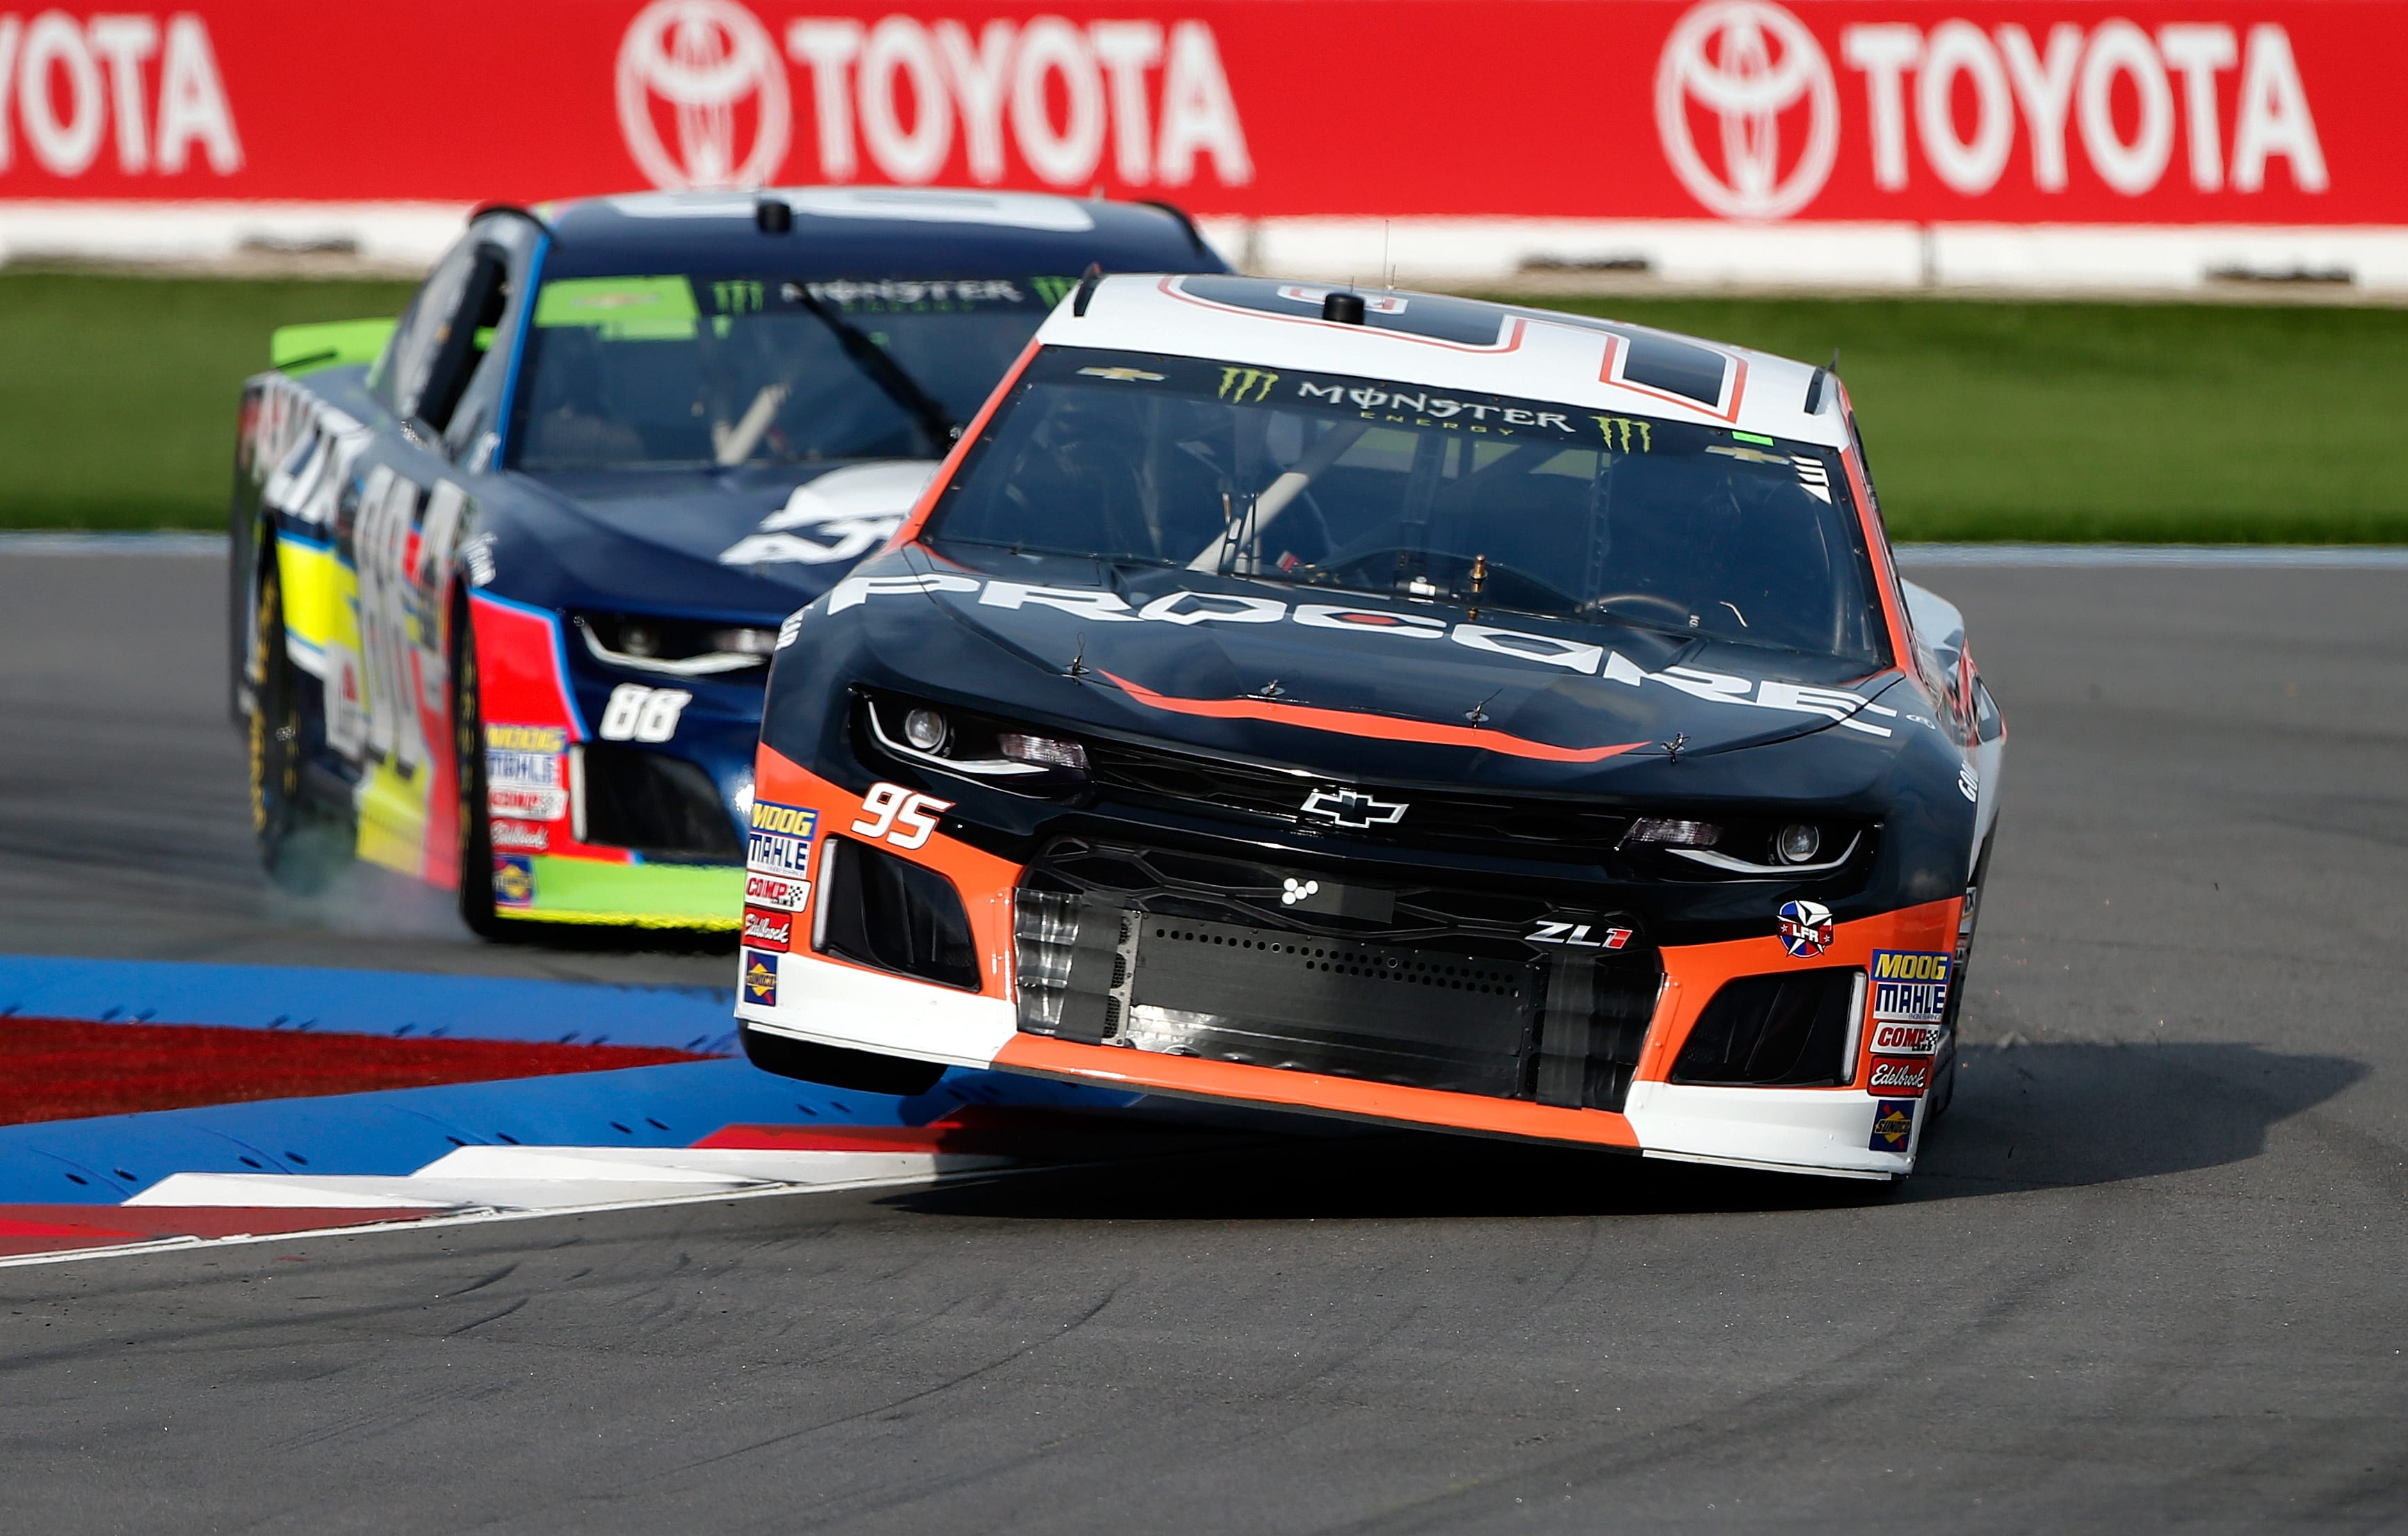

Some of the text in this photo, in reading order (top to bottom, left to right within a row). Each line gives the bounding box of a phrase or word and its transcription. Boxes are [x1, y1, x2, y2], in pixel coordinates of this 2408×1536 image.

[0, 13, 245, 177] OTA
[782, 14, 1255, 186] TOYOTA
[1839, 17, 2331, 197] TOYOTA
[1298, 381, 1576, 432] MONSTER
[1360, 411, 1514, 437] ENERGY
[599, 682, 693, 743] 88
[752, 802, 816, 836] MOOG
[850, 781, 957, 850] 95
[750, 834, 808, 871] MAHLE
[1524, 921, 1633, 949] ZL1
[1792, 923, 1819, 943] LFR
[1875, 953, 1948, 980] MOOG
[1875, 983, 1946, 1014] MAHLE
[1877, 1027, 1927, 1048] COMP
[1870, 1063, 1925, 1088] Edelbrock
